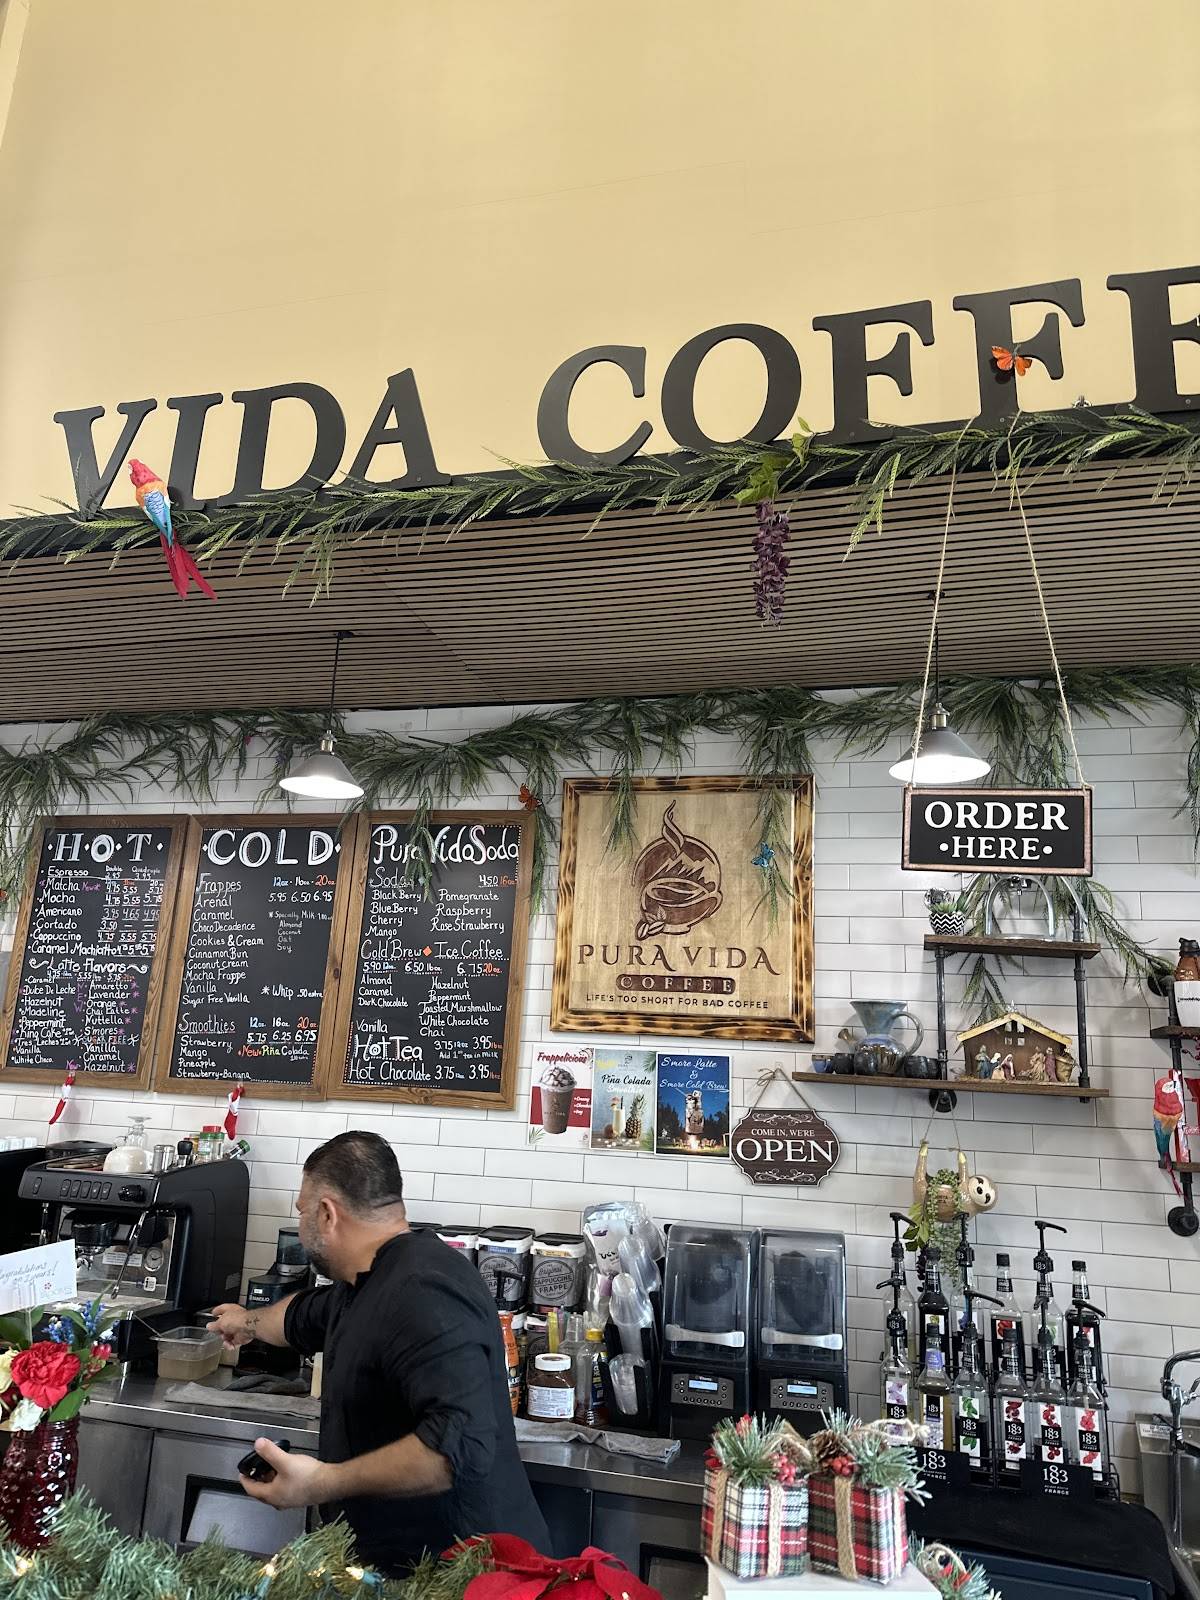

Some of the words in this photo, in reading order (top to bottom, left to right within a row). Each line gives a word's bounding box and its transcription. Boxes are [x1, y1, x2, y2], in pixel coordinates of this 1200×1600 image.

[53, 367, 452, 520] VIDA
[924, 801, 1070, 831] ORDER
[207, 829, 334, 868] COLD
[469, 825, 519, 865] Soda
[951, 836, 1041, 860] HERE
[47, 866, 89, 877] Espresso
[44, 877, 80, 892] Matcha
[195, 873, 242, 898] Frappes
[39, 889, 75, 903] Mocha
[194, 895, 232, 908] Arenal
[313, 890, 334, 902] 6.95
[372, 889, 398, 901] Black
[399, 890, 421, 902] Berry
[438, 889, 500, 904] Pomegranate
[36, 904, 83, 917] Americano
[194, 909, 234, 921] Caramel
[435, 902, 492, 920] Raspberry
[36, 918, 77, 930] Cortado
[370, 915, 403, 927] Cherry
[33, 928, 81, 943] Cappuccino
[190, 934, 226, 946] Cookies
[227, 934, 236, 946] &
[236, 935, 264, 946] Cream
[365, 926, 398, 940] Mango
[31, 941, 69, 955] Caramel
[188, 947, 230, 959] Cinnamon
[276, 943, 292, 954] Soy
[361, 939, 389, 960] Cold
[391, 939, 423, 959] Brew
[434, 941, 459, 958] Ice
[461, 939, 503, 959] Coffee
[47, 956, 80, 972] Latte
[187, 959, 220, 970] Coconut
[577, 944, 677, 972] PURA
[682, 946, 781, 976] VIDA
[184, 970, 215, 981] Mocha
[217, 967, 246, 985] Frappe
[360, 974, 393, 986] Almond
[431, 976, 469, 990] Hazelnut
[56, 983, 76, 995] Leche
[89, 980, 129, 991] Amaretto
[184, 980, 218, 994] Vanilla
[620, 976, 733, 992] COFFEE
[88, 990, 130, 1000] Lavender
[272, 984, 294, 1002] Whip
[358, 986, 394, 998] Caramel
[428, 989, 471, 1003] Peppermint
[24, 996, 64, 1008] Hazelnut
[86, 999, 117, 1008] Orange
[182, 995, 205, 1008] Sugar
[358, 997, 378, 1007] Dark
[377, 997, 409, 1008] Chocolate
[418, 1001, 451, 1016] Toasted
[450, 1001, 503, 1012] Marshmallow
[586, 994, 614, 1002] LIFE'S
[618, 994, 637, 1003] TOO
[641, 995, 674, 1005] SHORT
[678, 997, 699, 1006] FOR
[702, 997, 724, 1007] BAD
[728, 999, 769, 1009] COFFEE
[20, 1016, 66, 1031] Peppermint
[178, 1013, 236, 1032] Smoothies
[356, 1019, 389, 1034] Vanilla
[418, 1015, 446, 1027] White
[446, 1015, 490, 1027] Chocolate
[272, 1030, 292, 1041] 6.25
[294, 1029, 317, 1042] 6.95
[419, 1026, 446, 1037] Chai
[86, 1043, 118, 1054] Vanilla
[180, 1035, 233, 1053] Strawberry
[281, 1045, 309, 1056] Colada
[354, 1034, 391, 1061] Hot
[388, 1035, 424, 1061] Tea
[83, 1051, 121, 1061] Caramel
[180, 1047, 207, 1060] Mango
[84, 1063, 126, 1073] Hazelnut
[178, 1057, 217, 1069] Pineapple
[349, 1062, 375, 1081] Hot
[379, 1061, 431, 1081] Chocolate
[468, 1063, 490, 1080] 3.95
[623, 1075, 652, 1086] Colada
[751, 1128, 775, 1136] COME
[736, 1138, 835, 1163] OPEN
